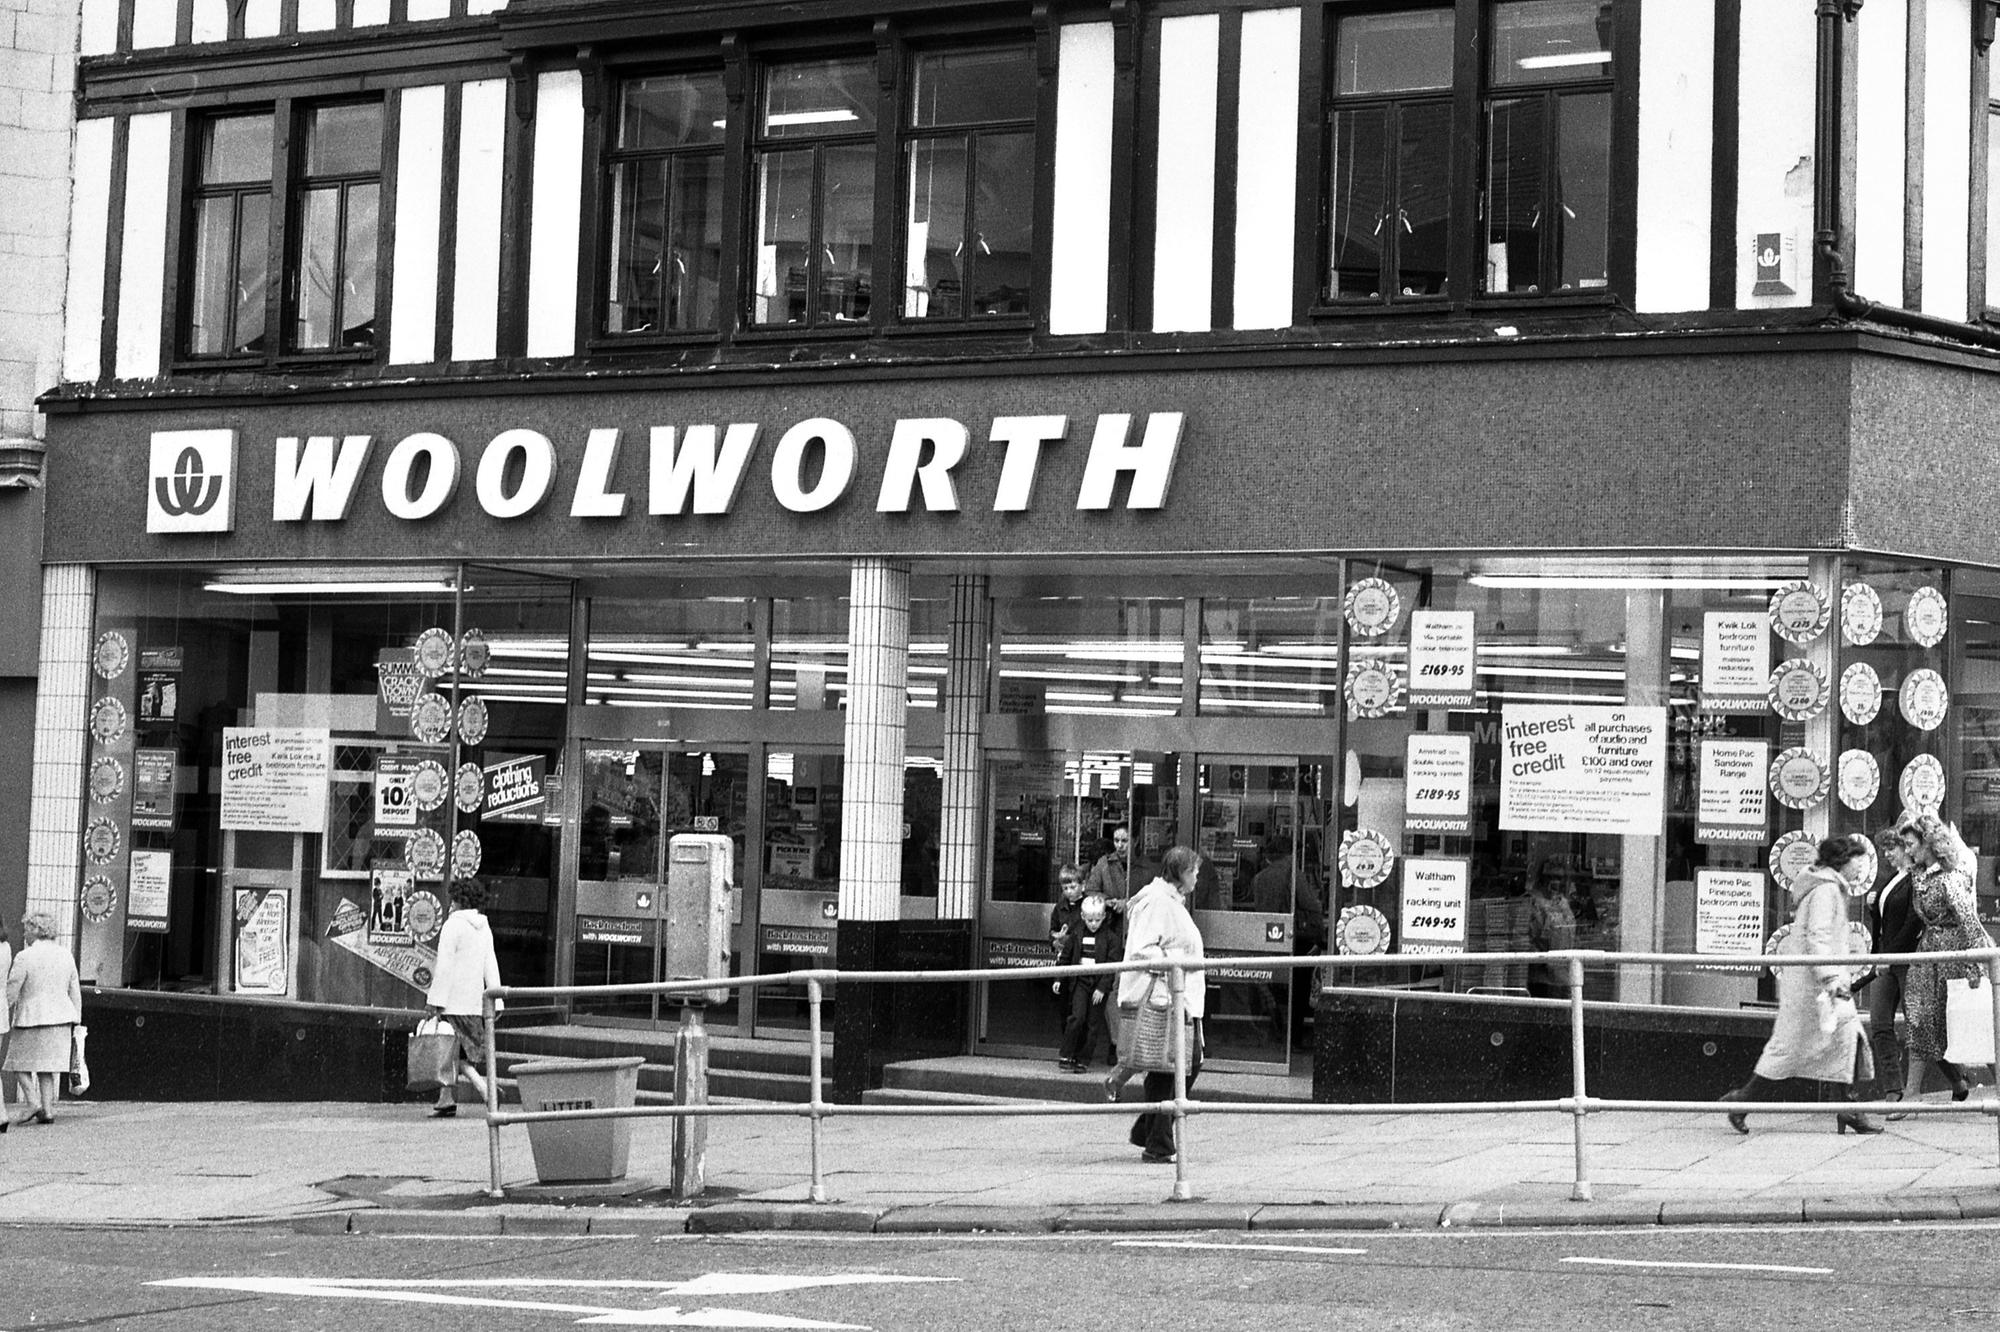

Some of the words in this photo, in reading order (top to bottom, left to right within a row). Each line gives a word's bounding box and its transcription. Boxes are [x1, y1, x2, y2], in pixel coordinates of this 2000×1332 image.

[272, 411, 1185, 521] WOOLWORTH
[1718, 622, 1738, 630] Kwik
[1741, 622, 1757, 630] Lok
[1720, 644, 1755, 652] furniture
[384, 676, 420, 688] CRACK
[386, 686, 416, 696] DOWN
[1409, 694, 1472, 706] WOOLWORTH
[1701, 699, 1768, 710] WOOLWORTH
[1612, 713, 1626, 722] on
[1505, 714, 1576, 740] interest
[1584, 722, 1596, 732] all
[1598, 723, 1652, 734] purchases
[225, 732, 271, 750] interest
[1588, 734, 1599, 744] of
[1600, 734, 1627, 744] audio
[1628, 735, 1648, 744] and
[1509, 740, 1548, 758] free
[1598, 745, 1638, 756] furniture
[1712, 749, 1738, 757] Home
[1739, 750, 1755, 758] Pac
[227, 750, 252, 765] free
[1582, 756, 1606, 766] £100
[1609, 757, 1628, 767] and
[1631, 760, 1653, 768] over
[1512, 753, 1566, 777] credit
[1714, 760, 1753, 768] Sandown
[228, 763, 263, 781] credit
[492, 763, 532, 789] clothing
[1720, 769, 1746, 778] Range
[381, 786, 413, 807] 10%
[487, 780, 540, 808] reductions
[132, 818, 172, 828] WOOLWORTH
[1405, 818, 1468, 831] WOOLWORTH
[1698, 828, 1766, 840] WOOLWORTH
[1415, 871, 1456, 882] Waltham
[1710, 878, 1734, 886] Home
[1736, 878, 1752, 887] Pac
[1708, 888, 1752, 898] Pinespace
[1406, 898, 1441, 909] racking
[1444, 900, 1462, 908] unit
[1700, 898, 1738, 907] bedroom
[1740, 898, 1760, 908] units
[127, 918, 168, 929] WOOLWORTH
[583, 918, 604, 930] Back
[370, 935, 413, 945] WOOLWORTH
[582, 932, 597, 941] with
[598, 933, 642, 944] WOOLWORTH
[766, 928, 789, 940] Back
[766, 943, 781, 952] with
[782, 943, 829, 954] WOOLWORTH
[1027, 944, 1056, 956] schoo
[1401, 944, 1465, 954] WOOLWORTH
[989, 956, 1006, 966] with
[1007, 956, 1057, 968] WOOLWORTH
[1220, 968, 1272, 980] WOOLWORTH
